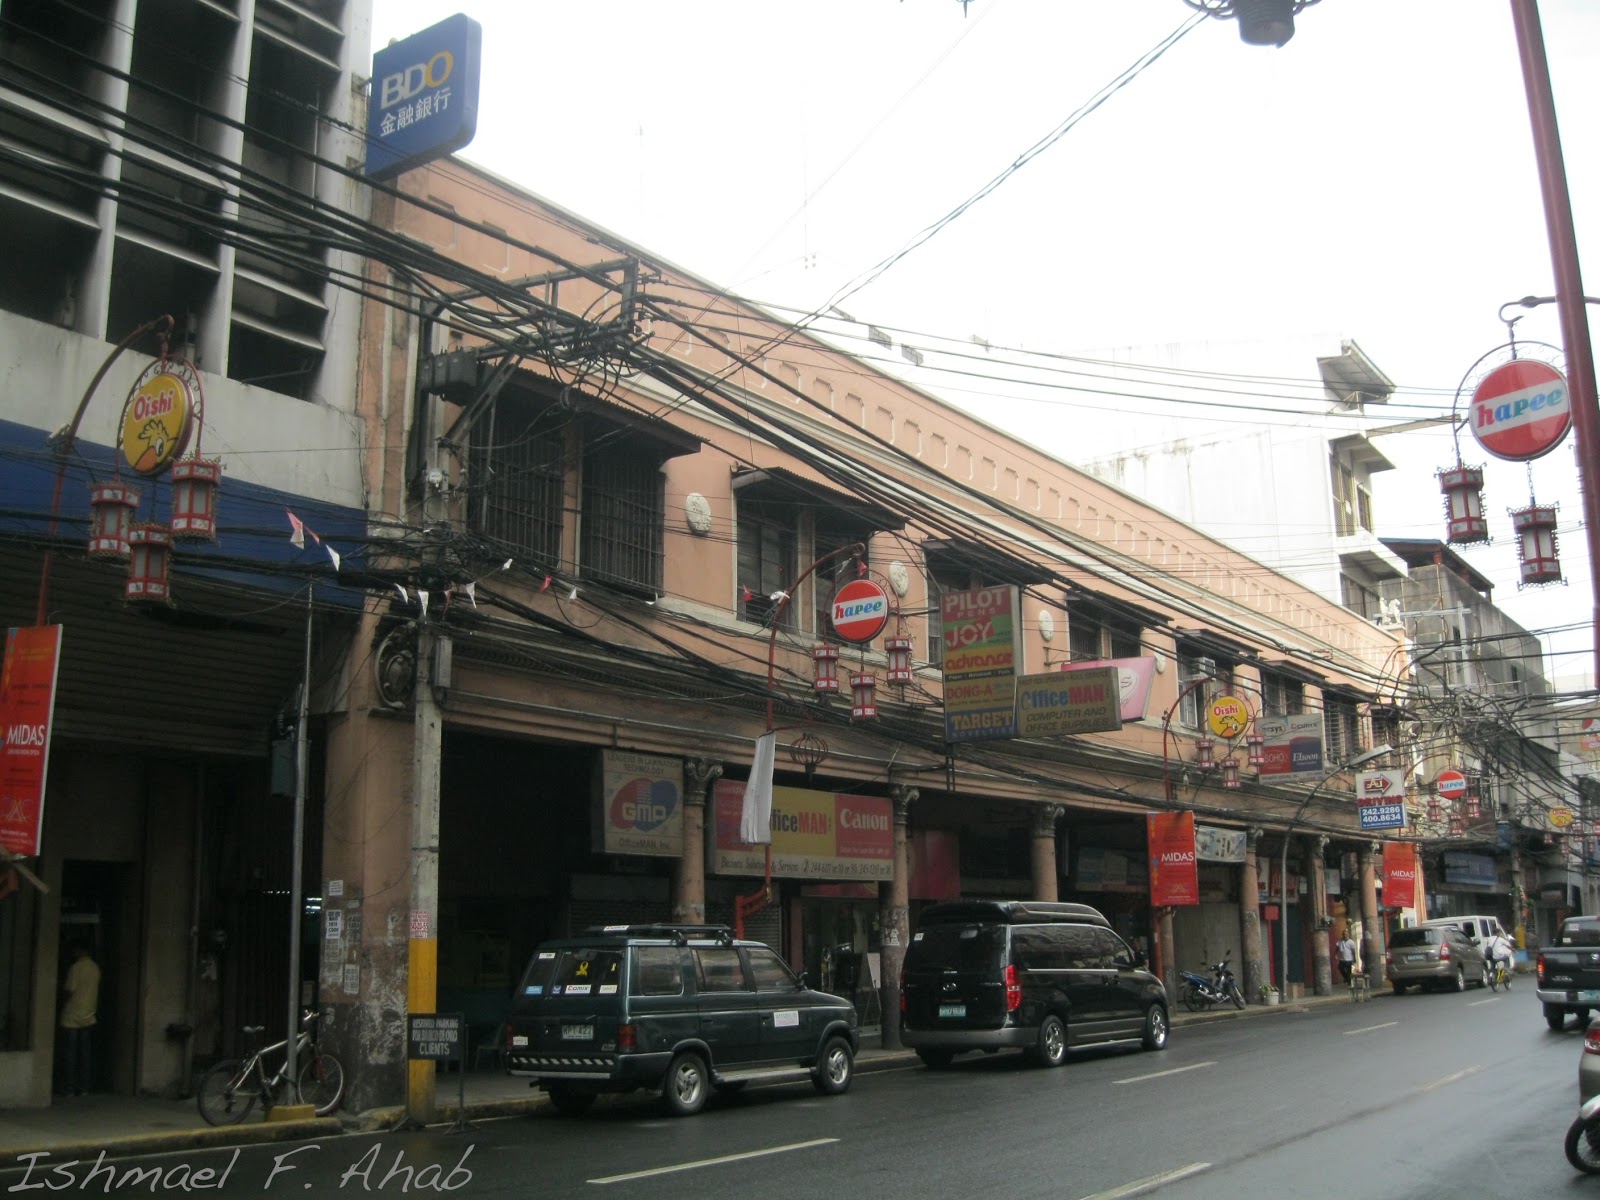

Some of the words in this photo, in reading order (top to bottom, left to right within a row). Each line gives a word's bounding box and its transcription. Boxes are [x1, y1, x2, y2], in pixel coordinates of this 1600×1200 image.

[381, 51, 453, 110] BDO
[380, 87, 451, 137] 金融銀行
[133, 388, 174, 422] Oishi
[1476, 388, 1563, 428] hapee
[945, 588, 1007, 613] PILOT
[835, 601, 882, 620] hapee
[957, 607, 996, 620] PENS
[946, 621, 992, 648] JOY
[945, 683, 992, 700] DONG-A
[1026, 708, 1081, 722] COMPUTER
[1083, 706, 1107, 717] AND
[1213, 704, 1239, 716] Oishi
[951, 711, 1013, 730] TARGET
[1025, 722, 1058, 733] OFFICE
[1061, 718, 1108, 730] SUPPLIES
[7, 725, 45, 746] MIDAS
[1264, 753, 1285, 763] SOHO
[623, 763, 665, 776] TECHNOLOGY
[622, 802, 666, 822] GMP
[840, 808, 889, 831] Canon
[1362, 805, 1400, 816] 242.9286
[1362, 813, 1402, 823] 400.8634
[770, 808, 827, 835] fficeMAN
[1161, 851, 1194, 862] MIDAS
[1391, 870, 1415, 879] MIDAS
[419, 1042, 450, 1055] CLIENTS
